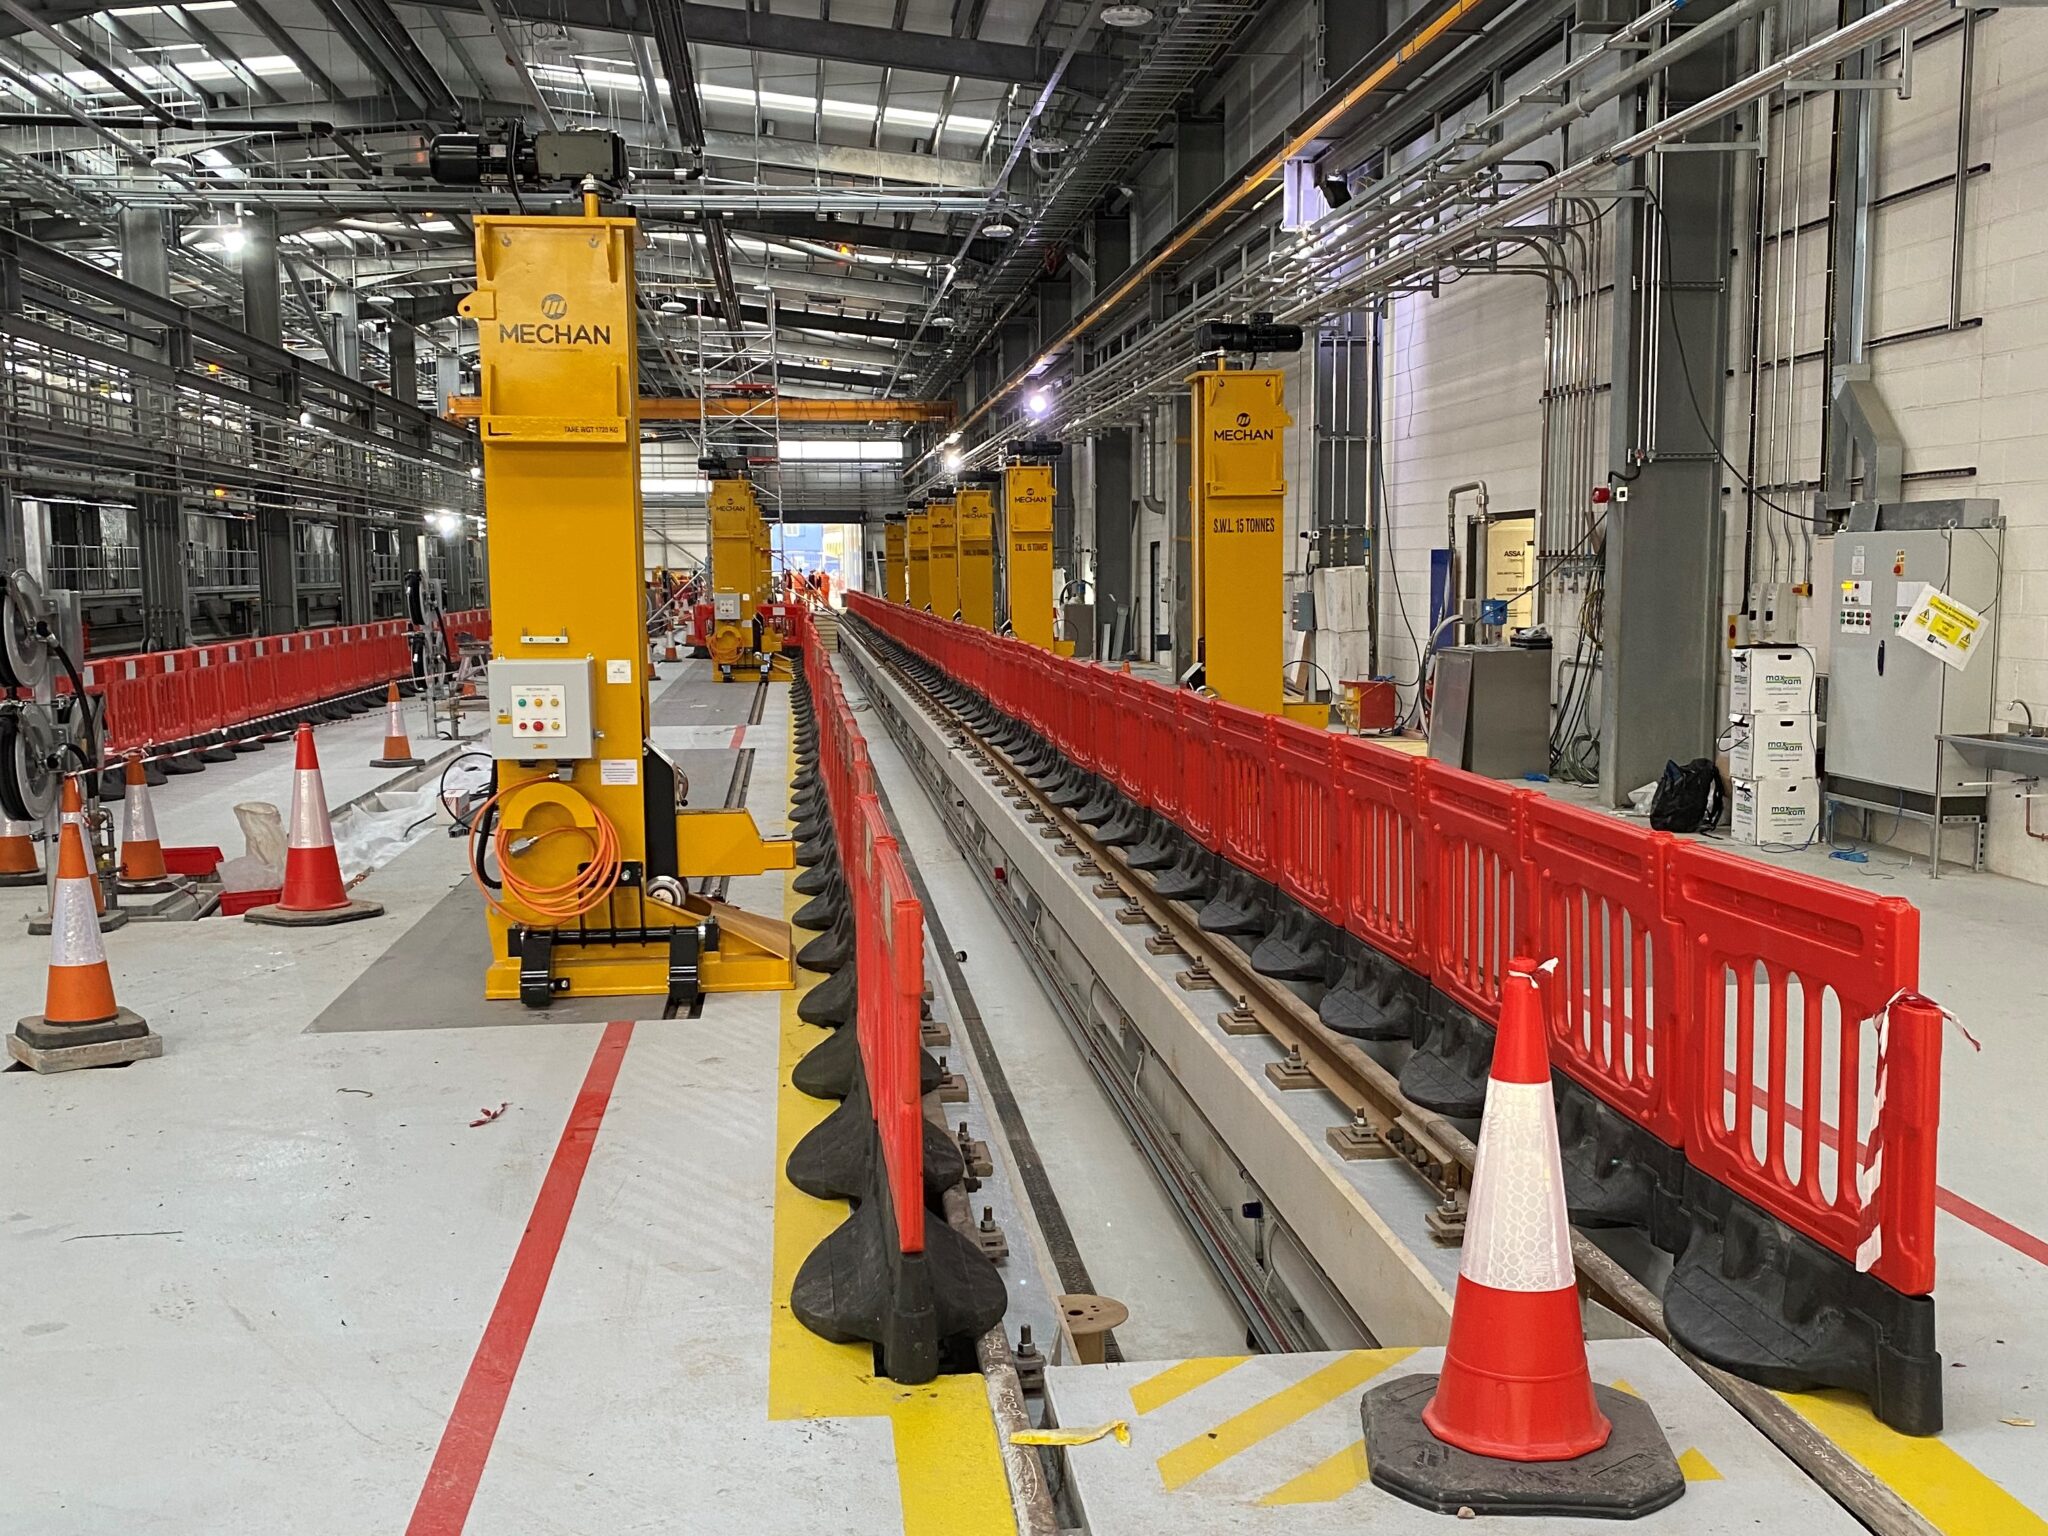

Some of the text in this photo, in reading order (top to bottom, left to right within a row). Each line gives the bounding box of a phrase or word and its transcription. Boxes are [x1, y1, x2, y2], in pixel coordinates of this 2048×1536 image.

[499, 323, 611, 345] MECHAN
[1214, 429, 1273, 441] MECHAN
[1236, 518, 1244, 533] 15
[1246, 517, 1275, 532] TONNES
